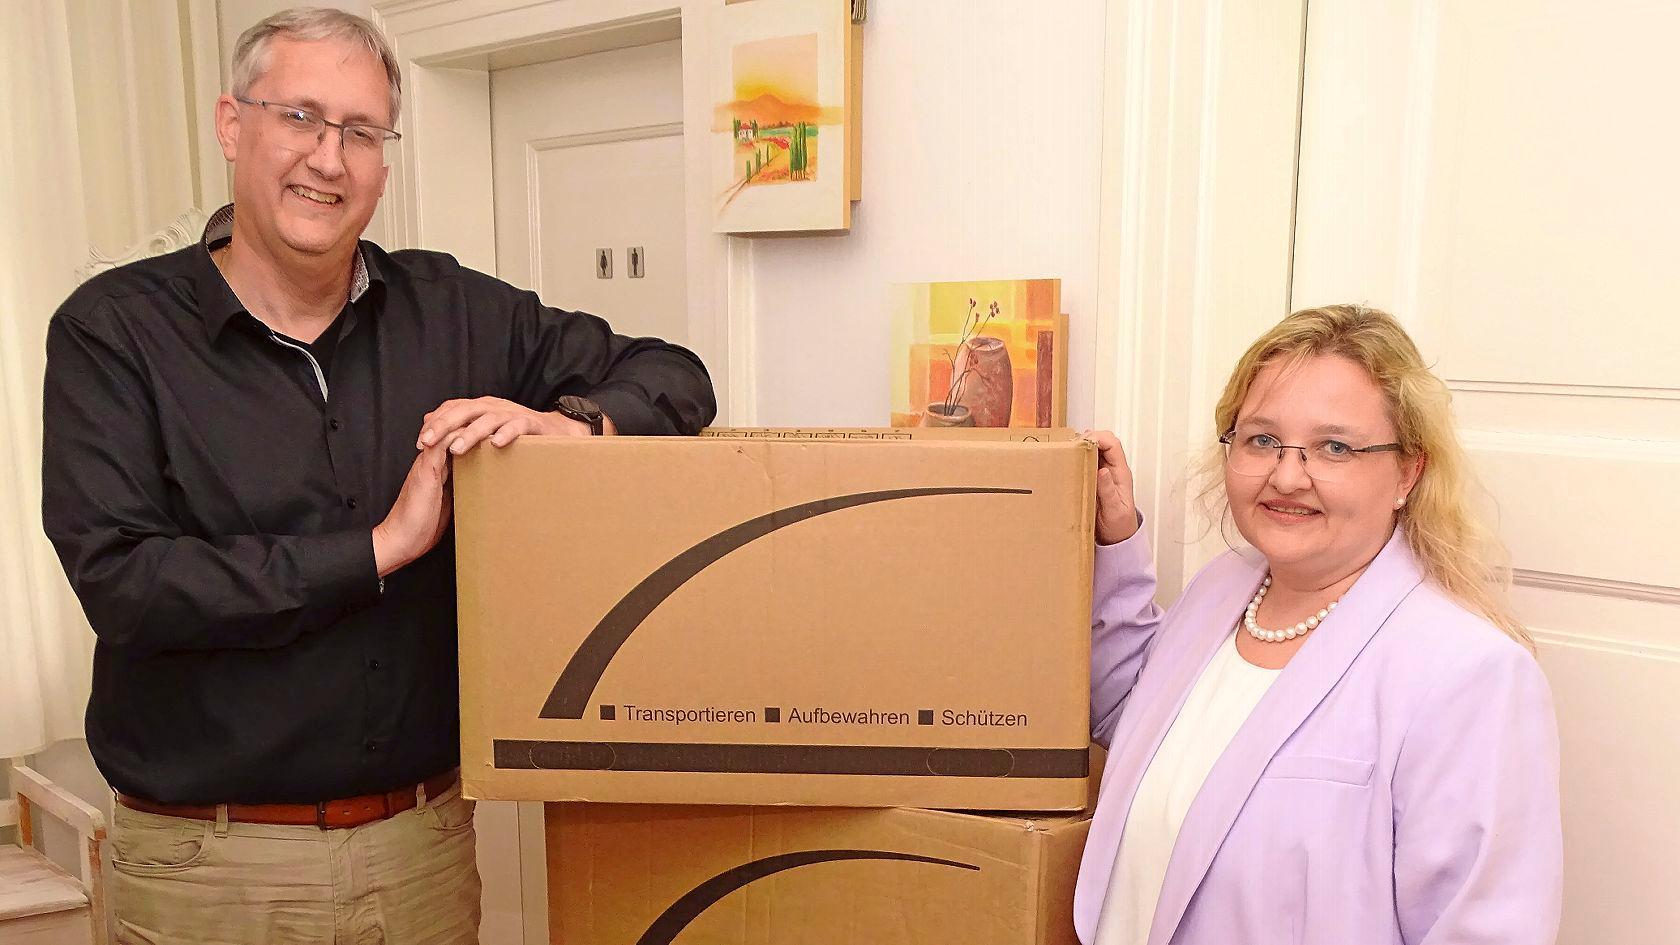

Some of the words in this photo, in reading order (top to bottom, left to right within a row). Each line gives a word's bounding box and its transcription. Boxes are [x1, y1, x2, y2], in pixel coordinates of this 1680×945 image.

[623, 704, 756, 726] Transportieren
[788, 707, 910, 725] Aufbewahren
[941, 708, 1028, 727] Schützen
